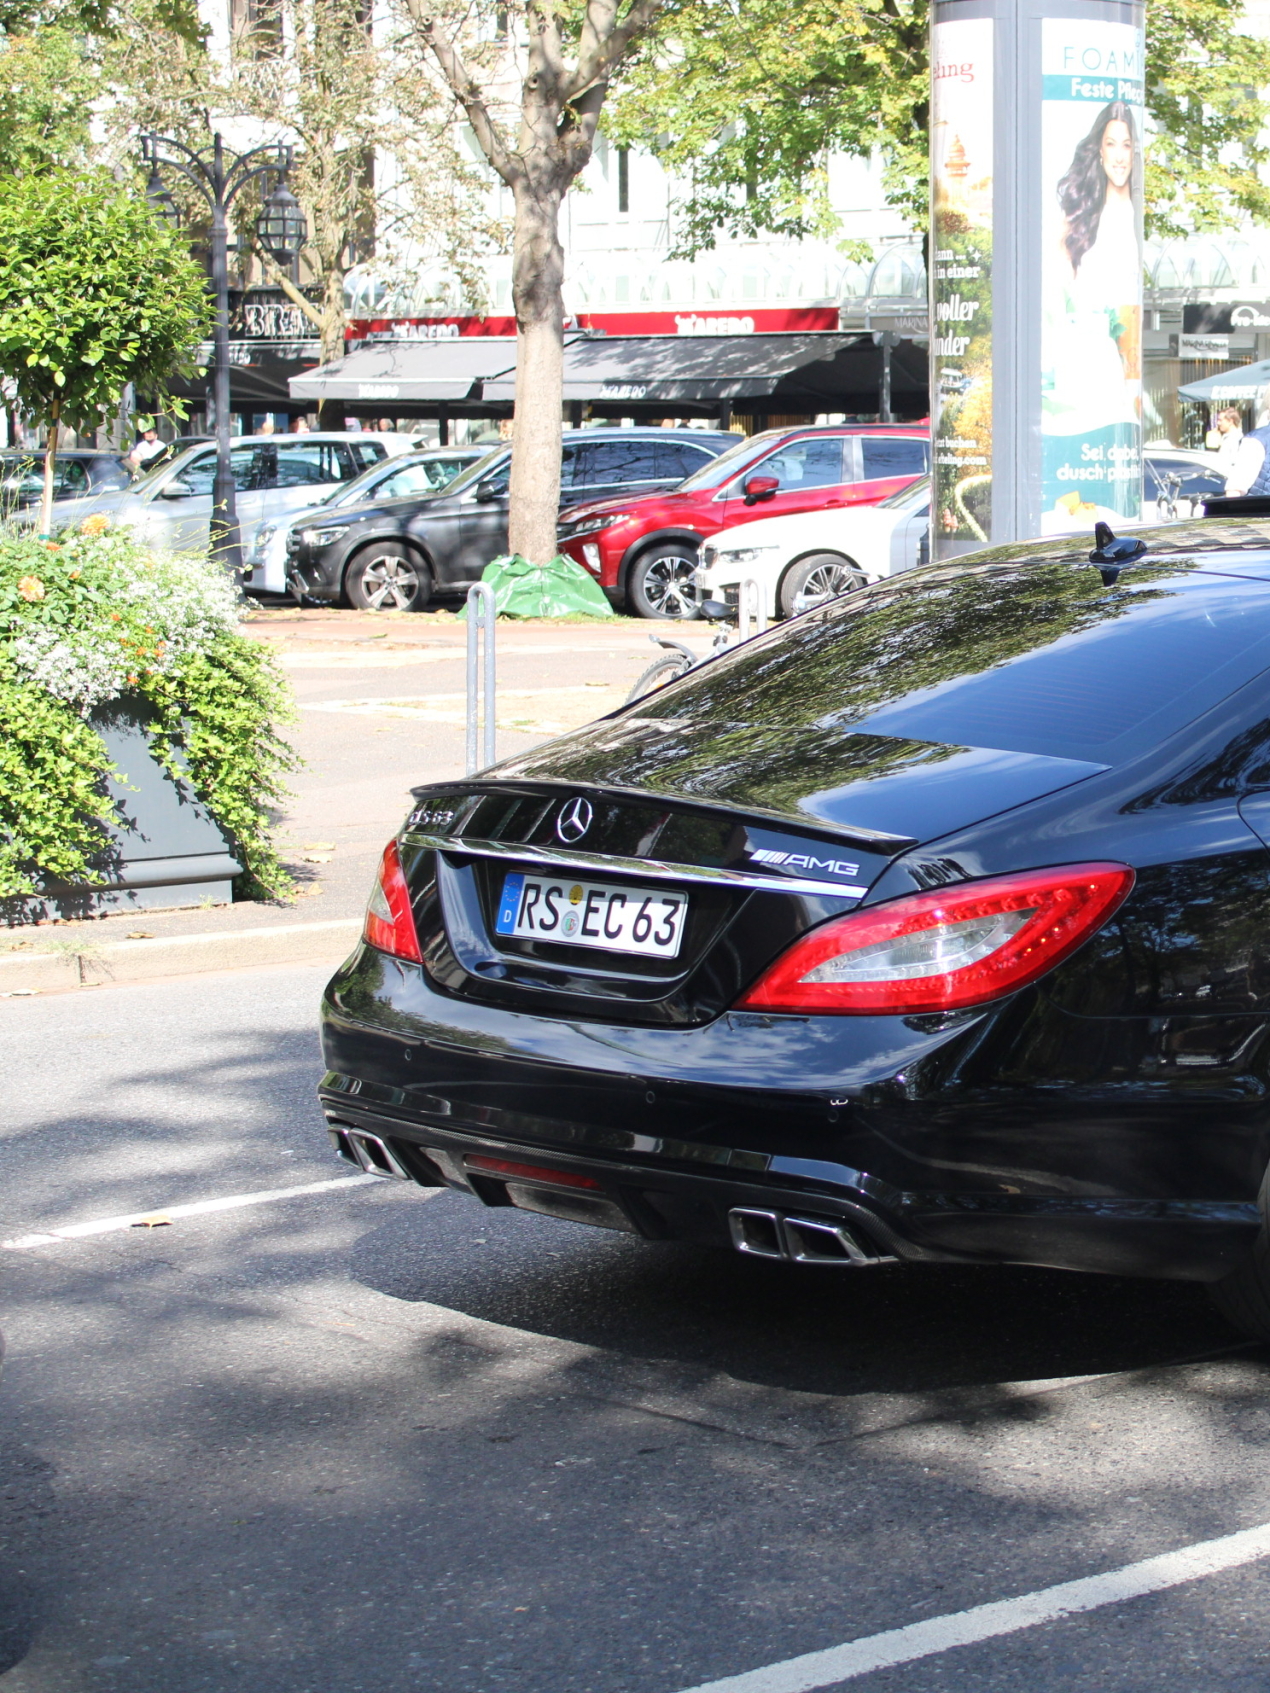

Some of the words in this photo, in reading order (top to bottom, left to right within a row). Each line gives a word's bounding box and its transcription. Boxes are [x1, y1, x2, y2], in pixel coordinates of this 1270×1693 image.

[1071, 77, 1115, 99] Feste
[947, 264, 981, 279] einer
[937, 294, 979, 321] voller
[1081, 443, 1104, 461] Sei
[1056, 462, 1104, 481] dusch
[782, 853, 860, 876] AMG
[503, 909, 513, 924] D
[518, 883, 563, 931] RS
[581, 890, 627, 939] EC
[632, 897, 680, 946] 63
